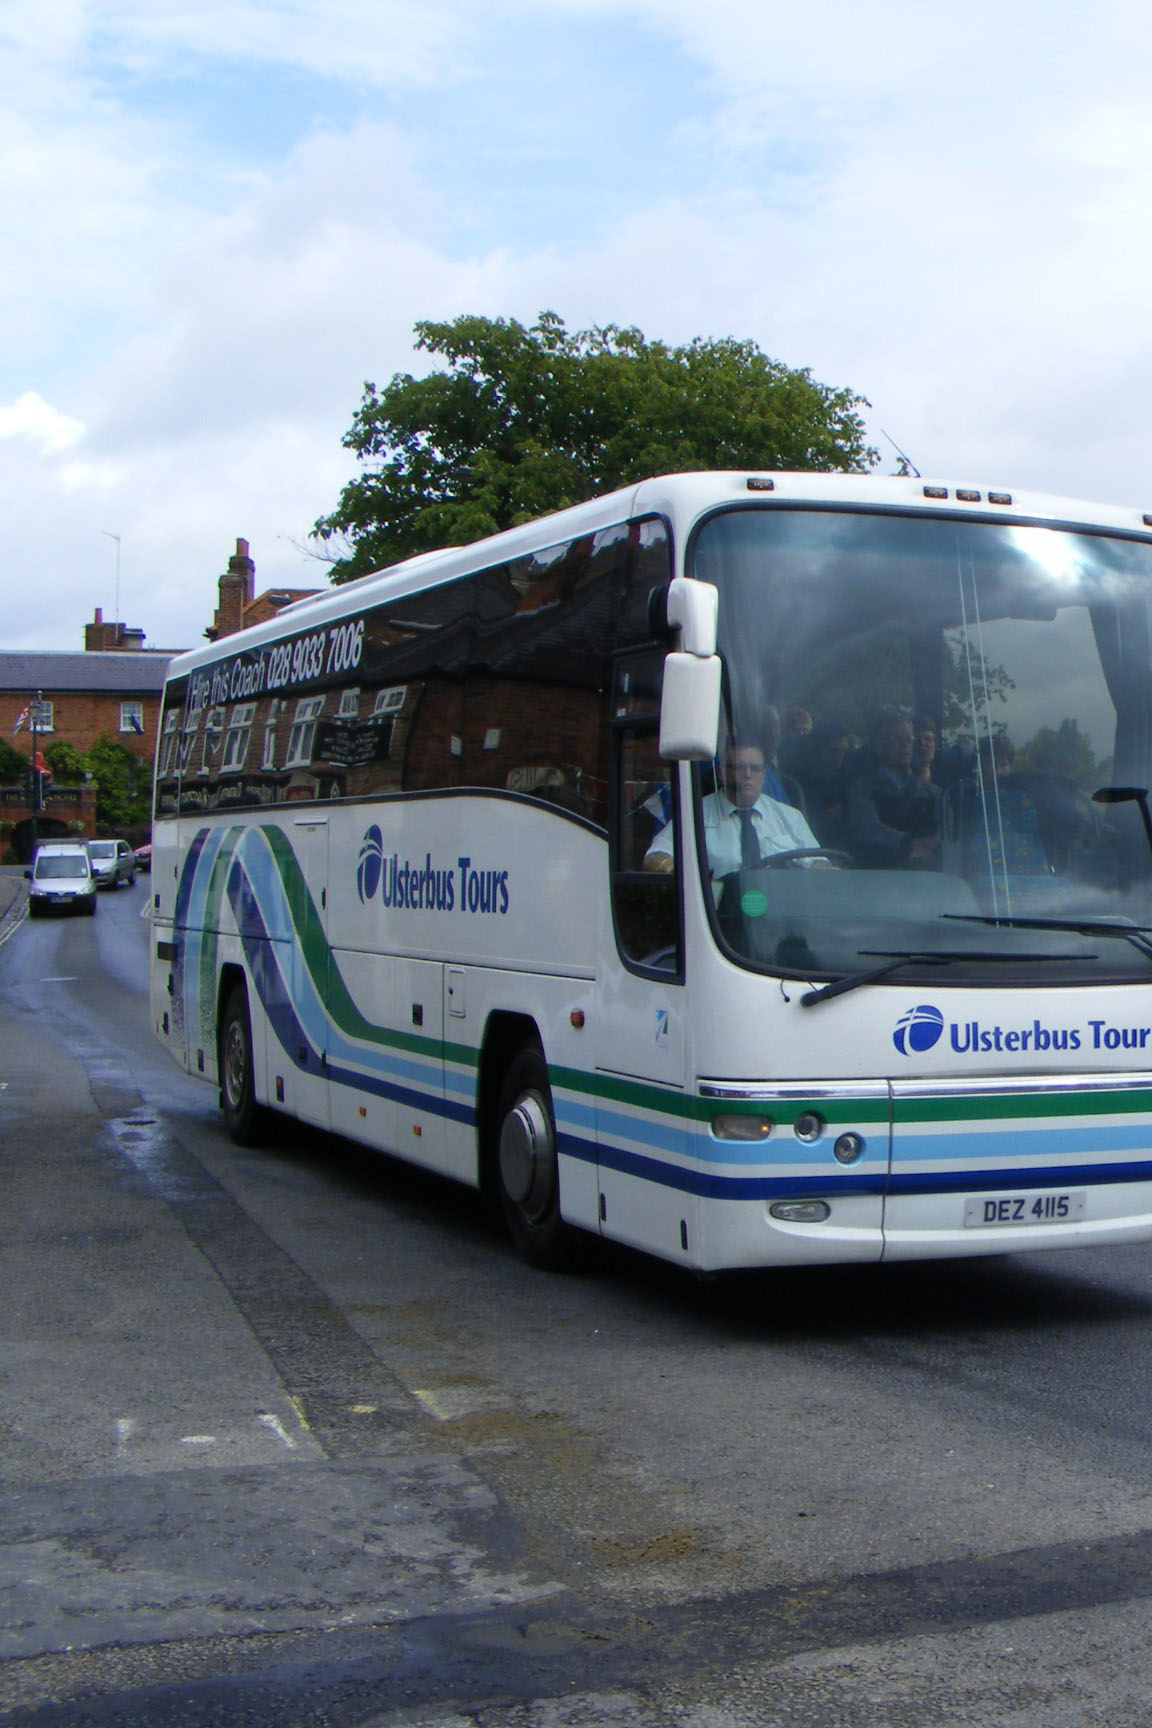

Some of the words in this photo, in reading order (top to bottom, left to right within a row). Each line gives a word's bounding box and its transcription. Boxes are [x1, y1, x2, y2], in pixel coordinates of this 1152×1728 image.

[191, 673, 210, 709] Hire
[210, 664, 229, 705] this
[230, 652, 266, 700] Coach
[267, 642, 292, 690] 028
[291, 632, 326, 684] 9033
[326, 619, 365, 674] 7006
[382, 853, 455, 912] Ulsterbus
[458, 857, 509, 915] Tours
[950, 1020, 1081, 1053] Ulsterbus
[983, 1198, 1026, 1222] DEZ
[1031, 1196, 1070, 1219] 4115
